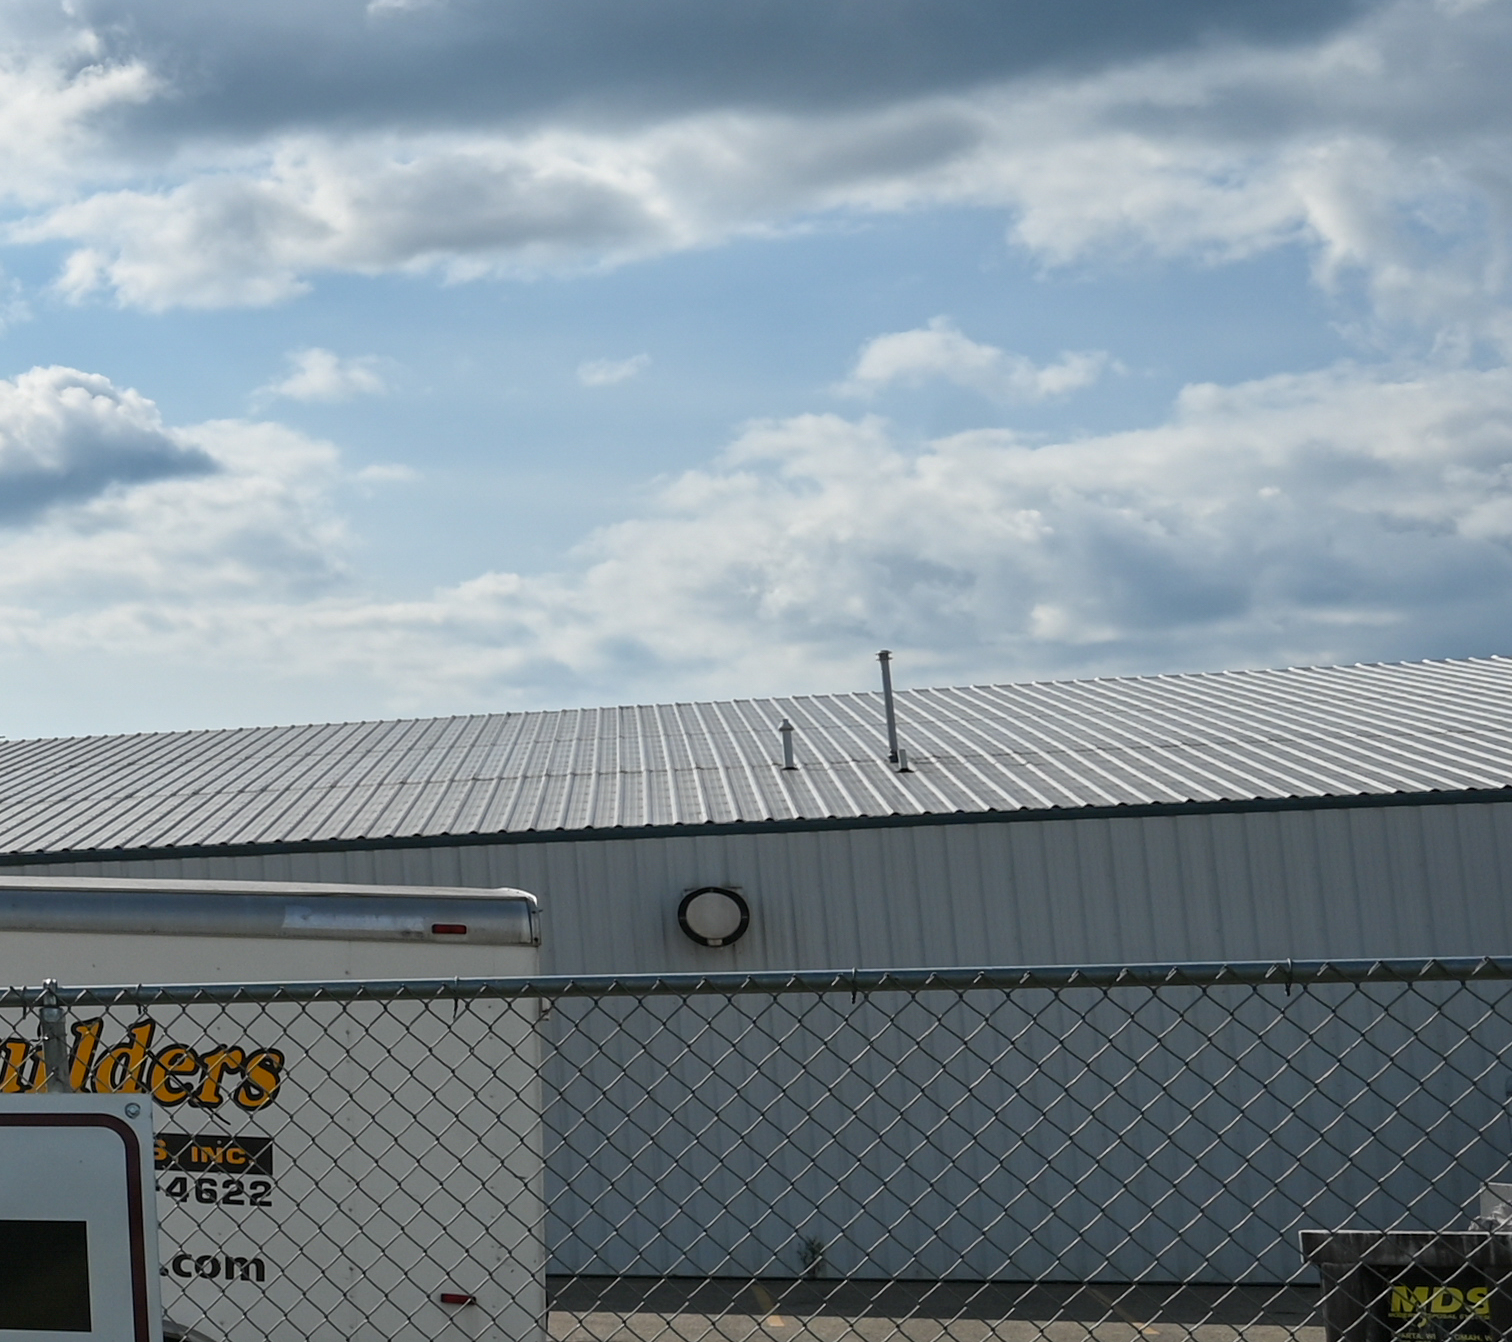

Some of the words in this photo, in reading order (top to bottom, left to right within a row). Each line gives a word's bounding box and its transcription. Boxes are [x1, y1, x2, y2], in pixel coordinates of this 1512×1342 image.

[191, 1146, 255, 1164] INC.
[159, 1254, 265, 1282] .com
[1391, 1286, 1490, 1315] MDS
